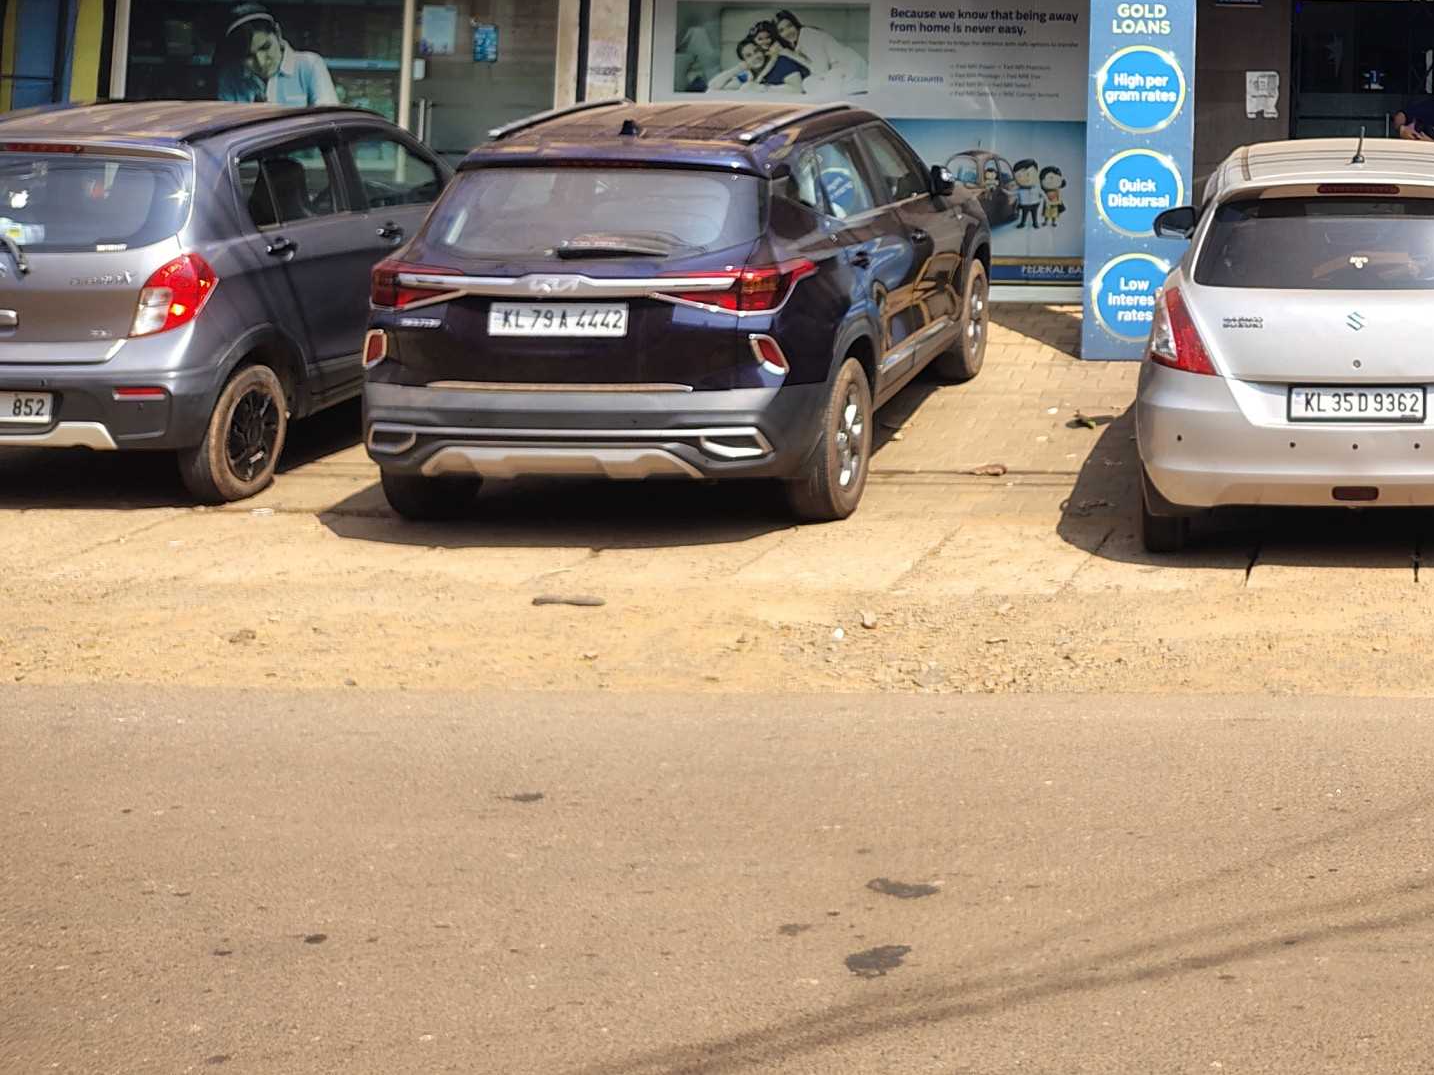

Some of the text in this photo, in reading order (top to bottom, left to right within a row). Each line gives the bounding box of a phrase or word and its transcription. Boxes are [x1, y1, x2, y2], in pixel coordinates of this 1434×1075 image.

[890, 7, 1079, 24] Because we know that being away
[1117, 3, 1167, 19] GOLD
[890, 21, 1027, 37] from home is never easy.
[1112, 20, 1171, 35] LOANS
[906, 75, 944, 83] Accounts
[1114, 73, 1169, 89] High per
[1105, 89, 1177, 104] gram rates
[1119, 179, 1157, 194] Quick
[1108, 192, 1170, 209] Disbursal
[1021, 264, 1066, 275] FEDERAL
[1119, 276, 1150, 291] Low
[501, 308, 624, 331] KL 79 A 4442
[1117, 308, 1153, 322] rates
[12, 398, 45, 417] 852
[1303, 392, 1421, 413] KL 35 D 9362
